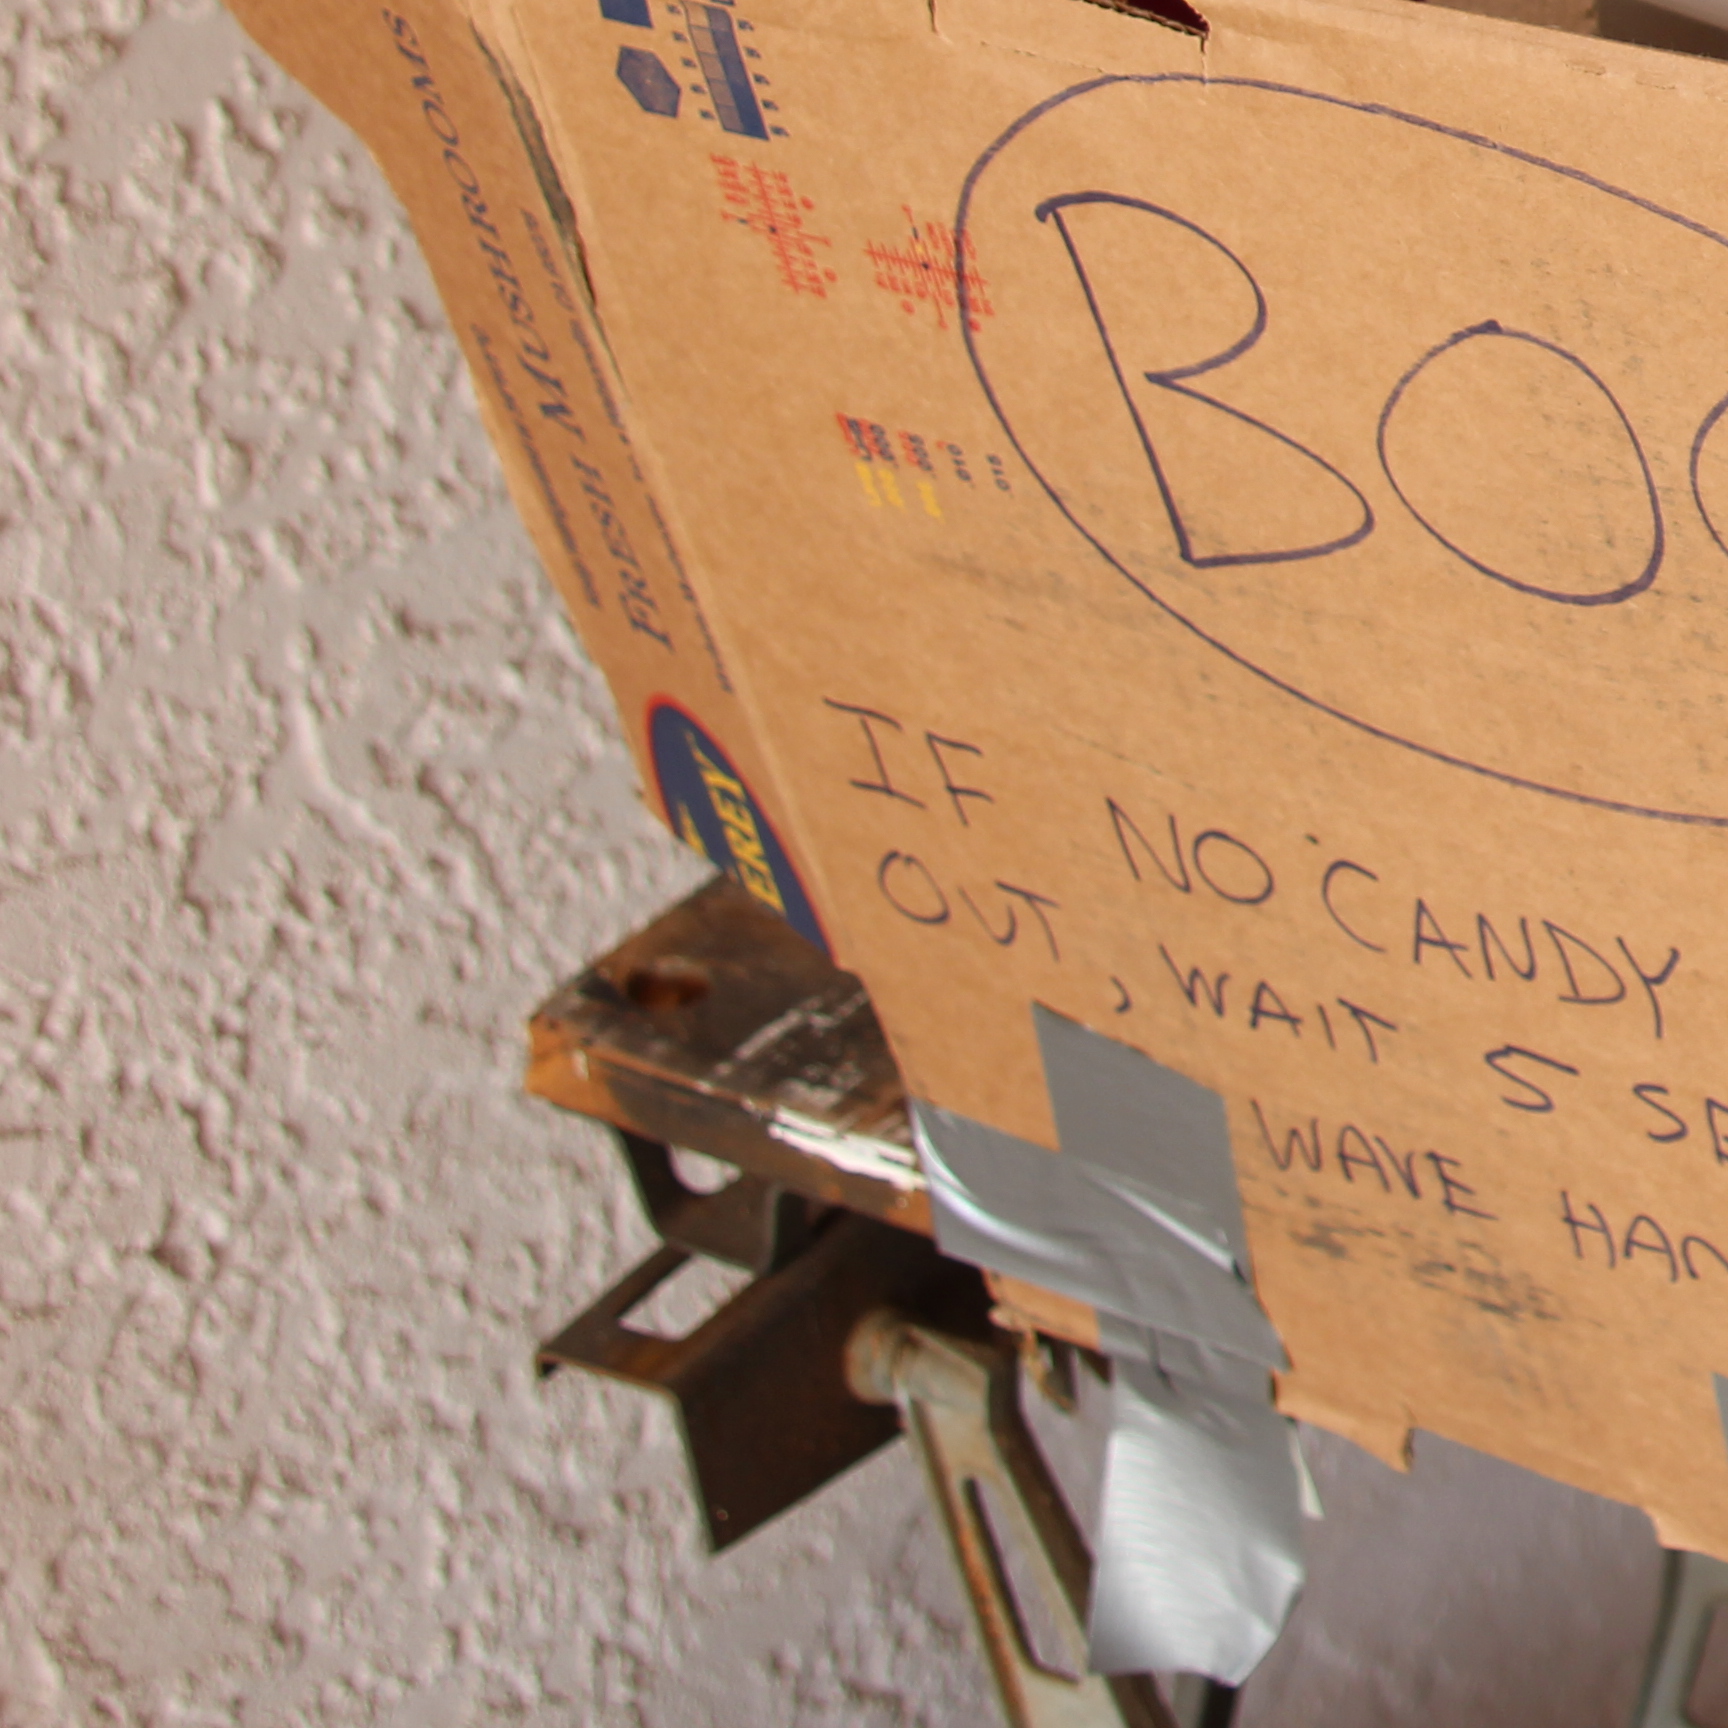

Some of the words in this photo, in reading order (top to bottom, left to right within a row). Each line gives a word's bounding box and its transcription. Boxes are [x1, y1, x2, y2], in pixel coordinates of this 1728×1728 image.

[380, 6, 587, 444] MUSHROOMS
[570, 452, 677, 655] FRESH
[823, 696, 994, 827] IF
[1105, 796, 1276, 906] NO
[1320, 859, 1681, 1040] CANDY
[1159, 942, 1398, 1064] WAIT
[1250, 1097, 1498, 1221] WAVE
